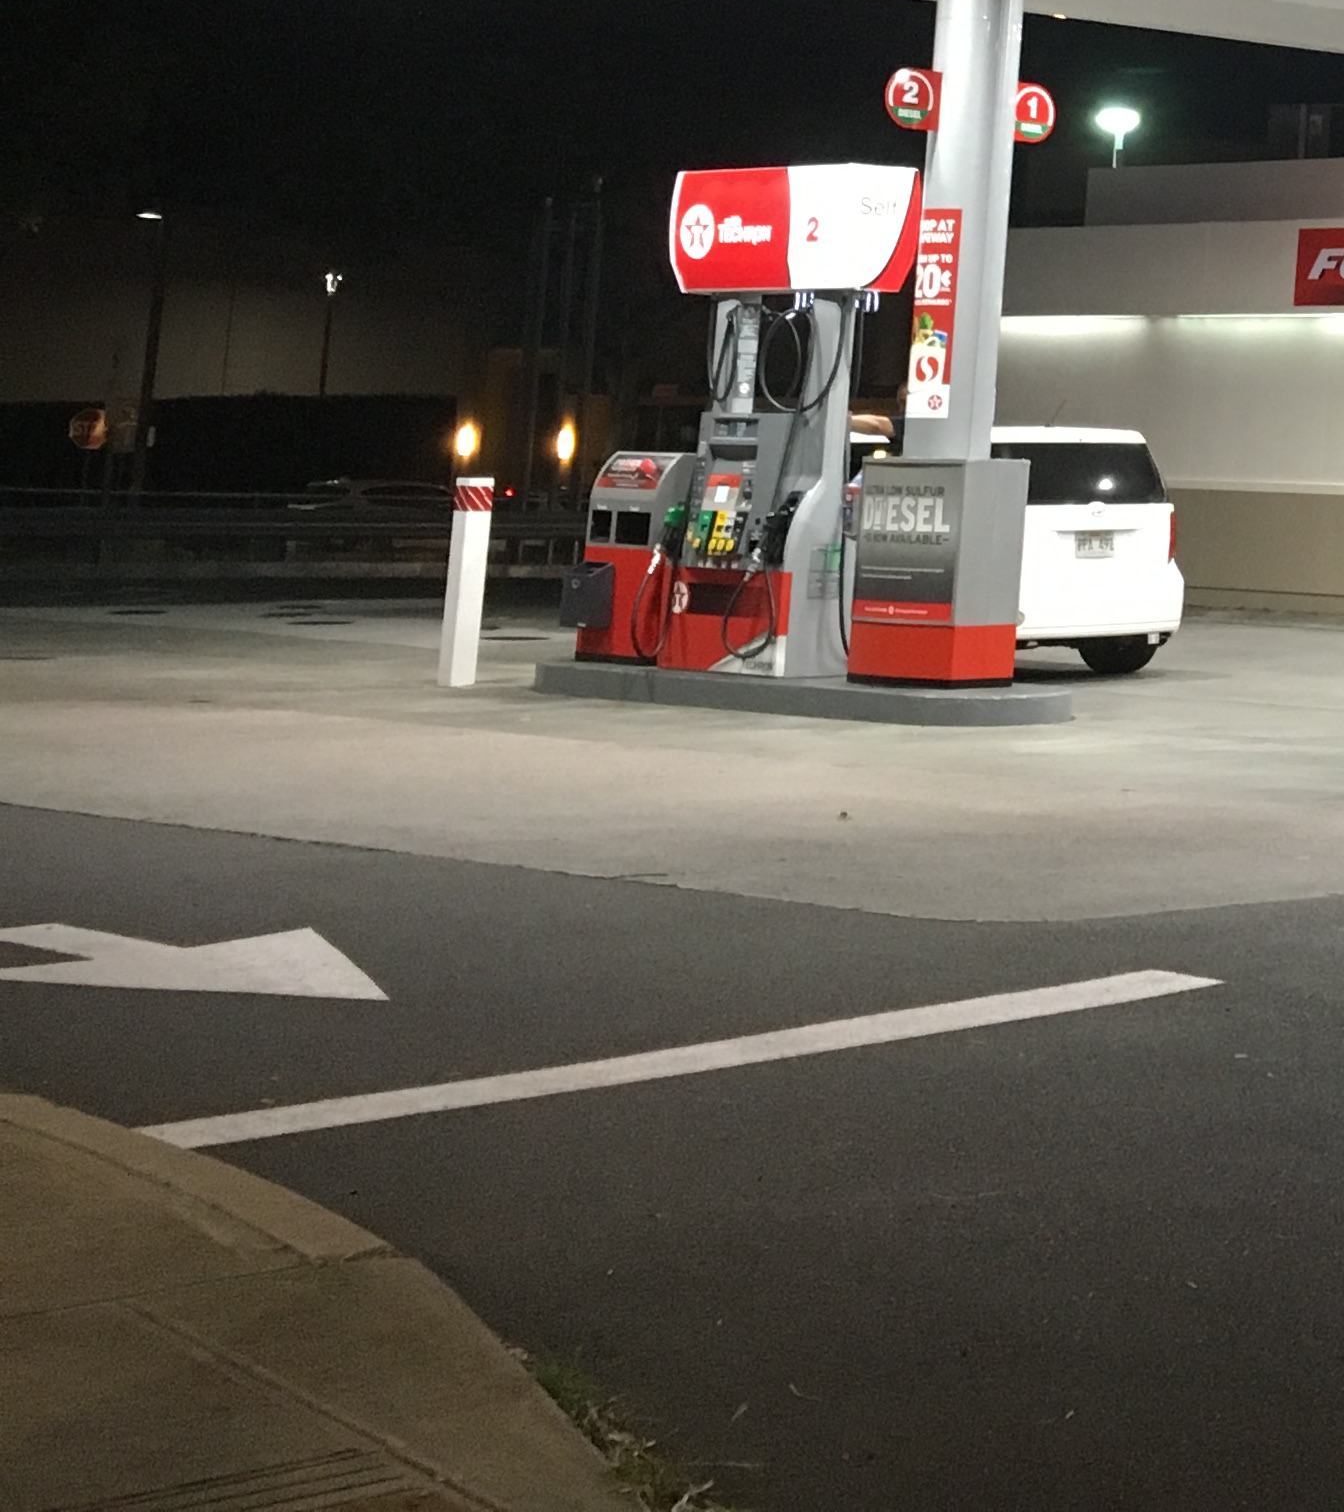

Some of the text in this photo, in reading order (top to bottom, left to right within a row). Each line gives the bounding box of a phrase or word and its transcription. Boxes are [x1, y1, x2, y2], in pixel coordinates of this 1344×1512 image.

[902, 81, 920, 105] 2
[1027, 96, 1038, 119] 1
[806, 217, 819, 242] 2
[863, 497, 950, 533] DIESEL
